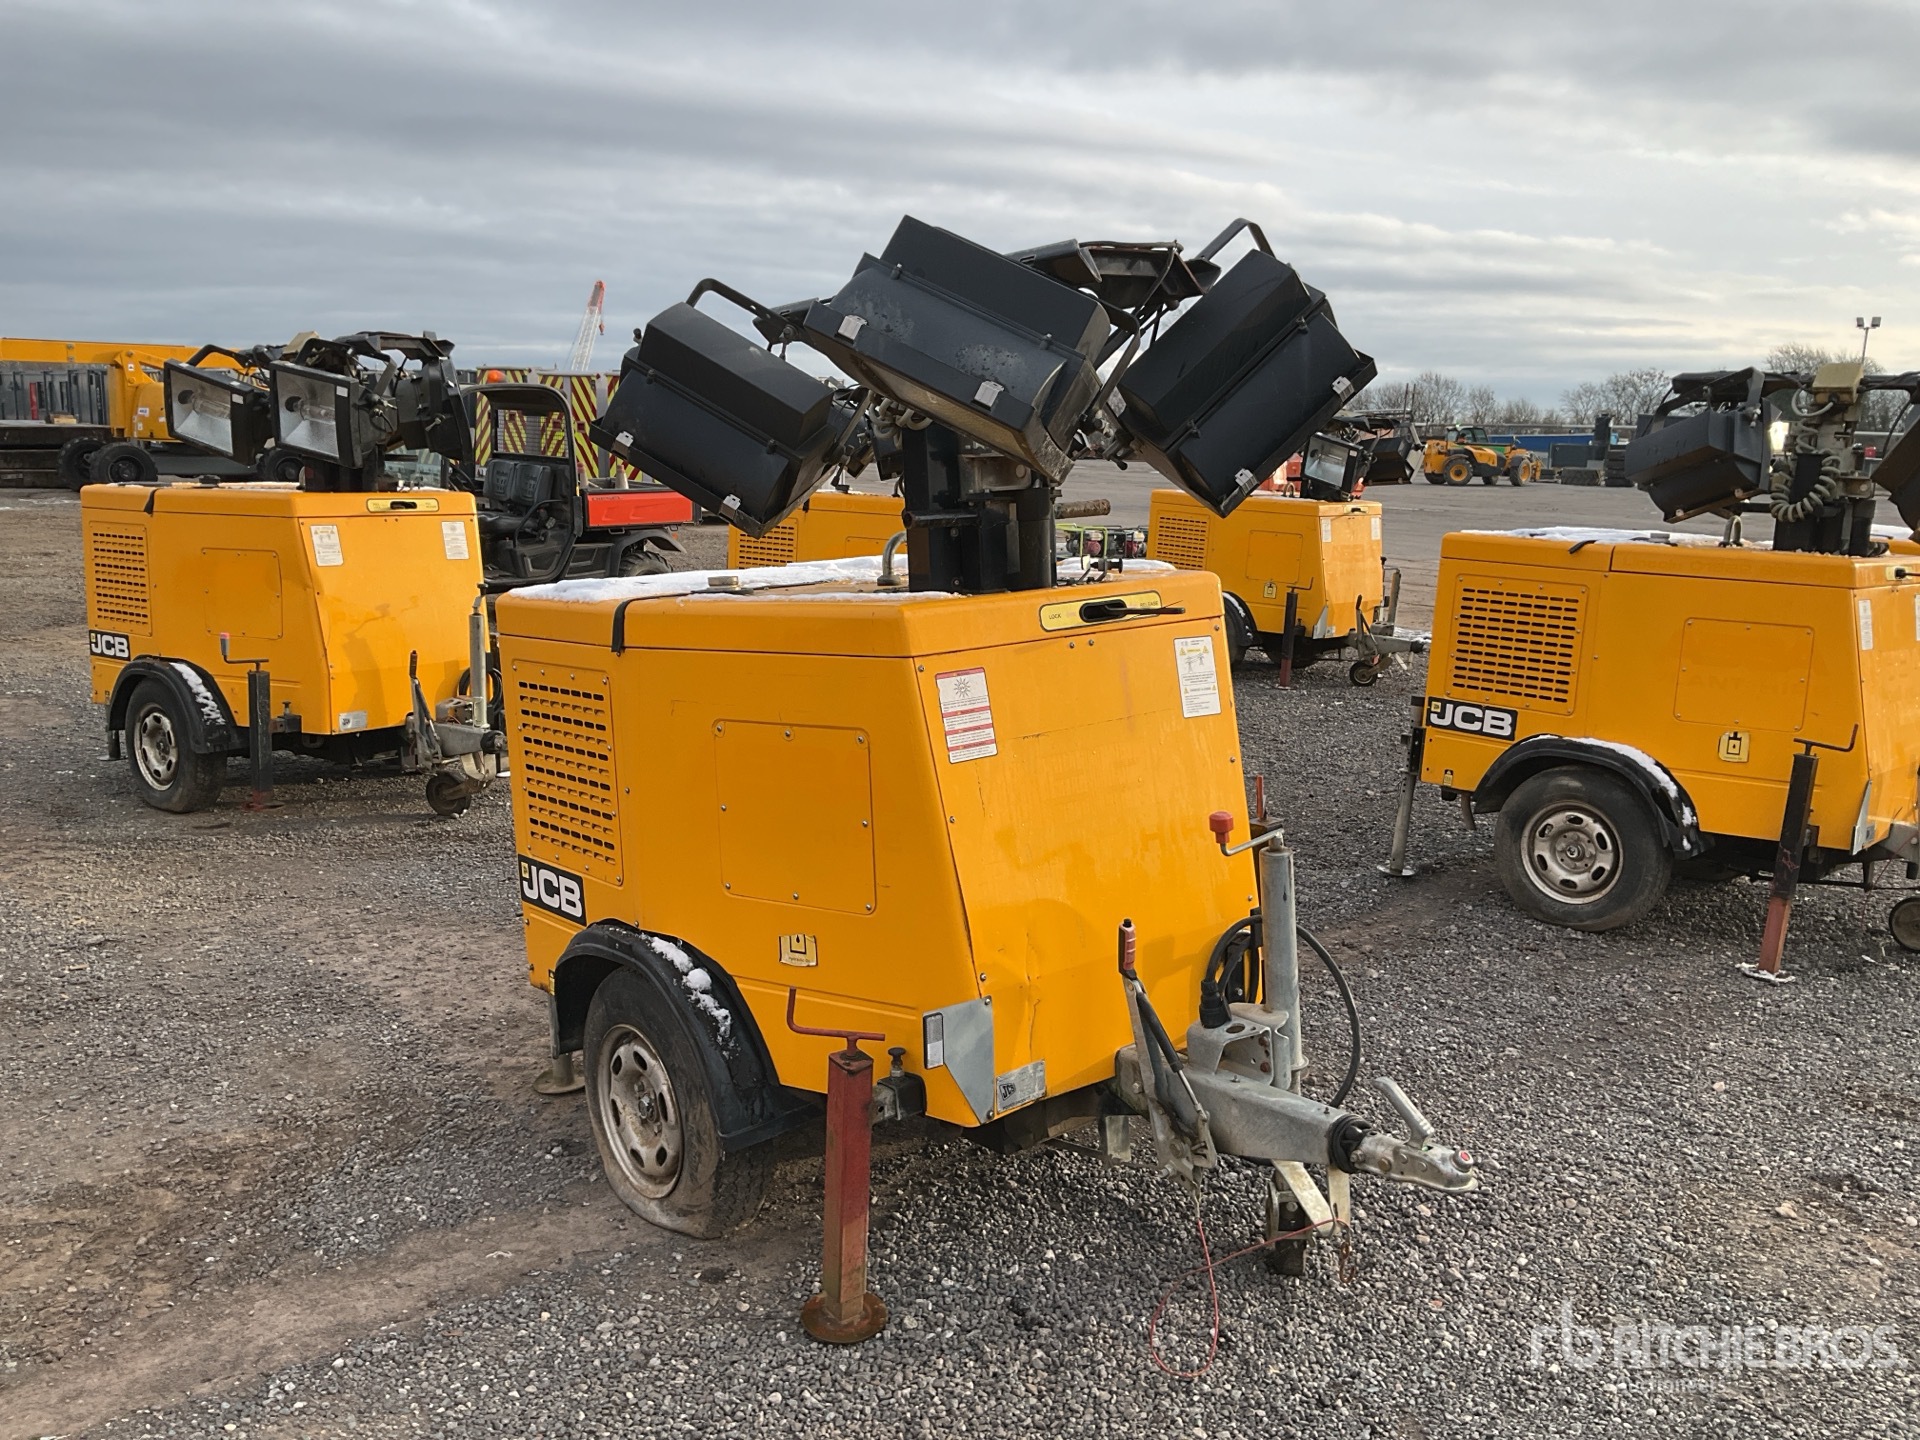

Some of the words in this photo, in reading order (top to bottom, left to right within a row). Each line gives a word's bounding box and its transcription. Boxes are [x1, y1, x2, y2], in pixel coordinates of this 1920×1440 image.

[1140, 600, 1159, 608] RELEASE
[91, 633, 129, 658] JCB
[1430, 703, 1512, 736] JCB
[522, 865, 583, 918] JCB
